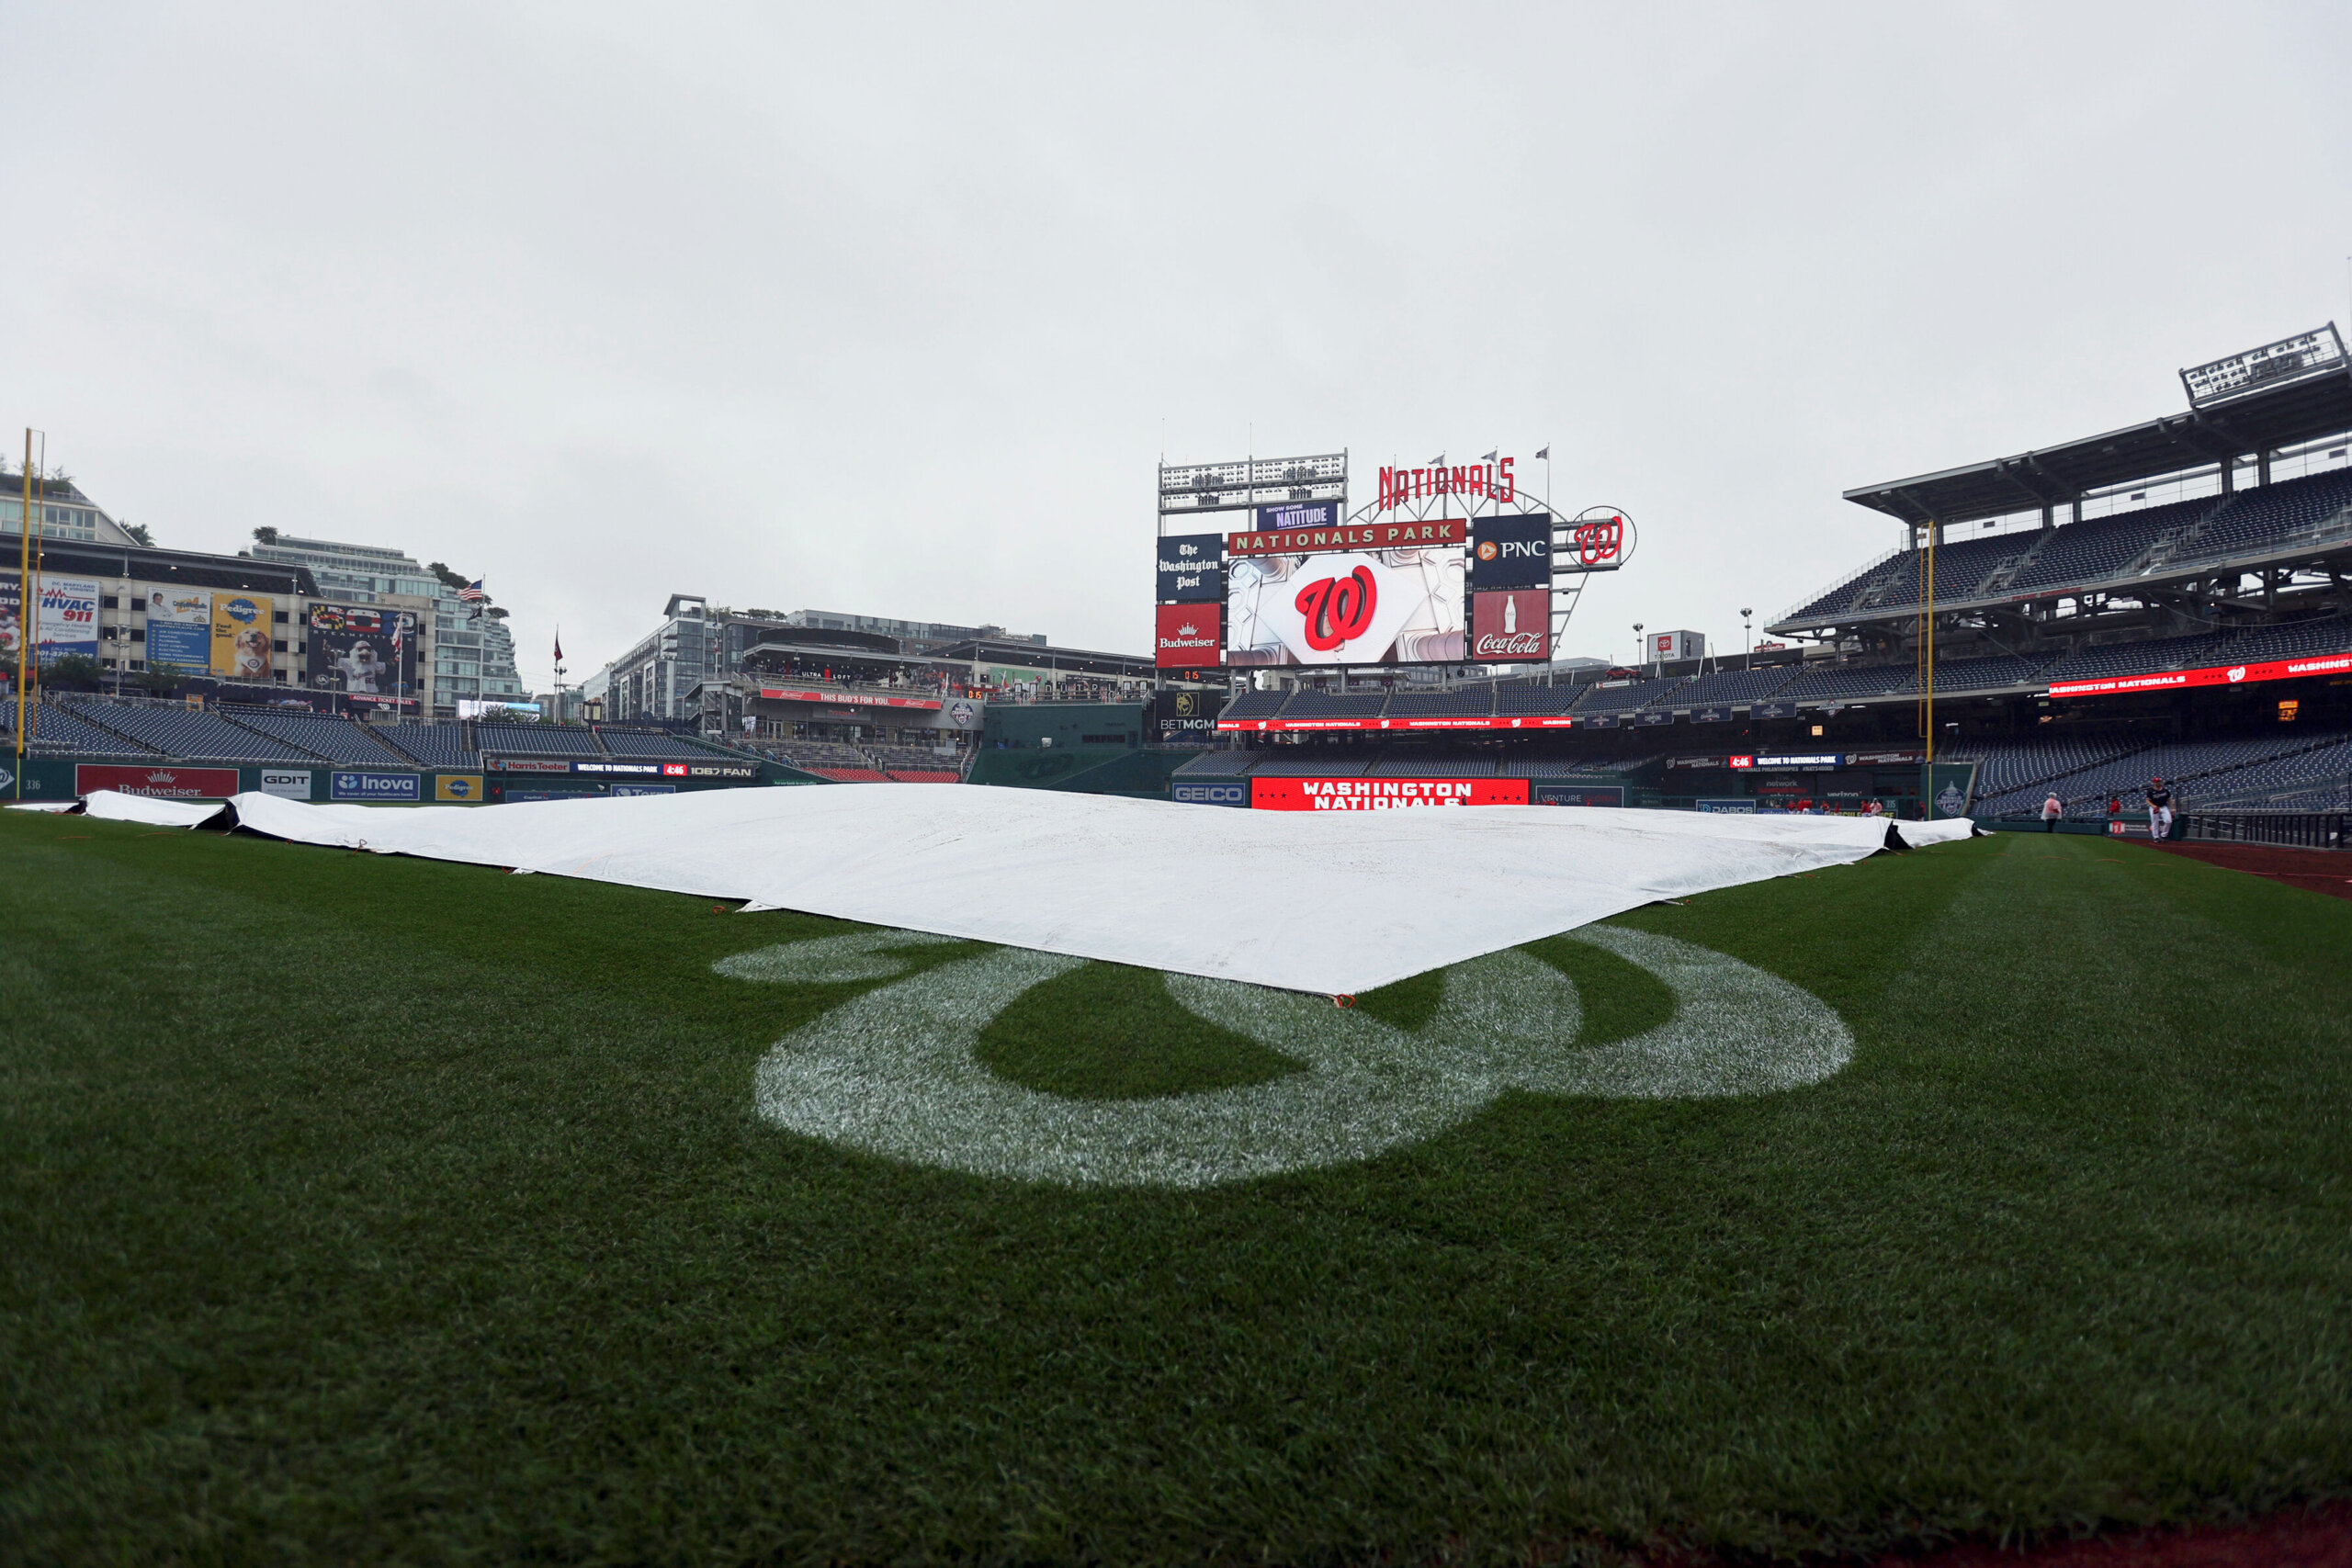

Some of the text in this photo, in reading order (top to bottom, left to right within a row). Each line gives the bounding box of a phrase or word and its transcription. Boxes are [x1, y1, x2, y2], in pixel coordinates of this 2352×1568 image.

[1379, 457, 1514, 512] NATIONALS
[1276, 507, 1328, 527] NATITUDE
[1236, 524, 1452, 549] NATIONALS PARK
[1179, 544, 1199, 557] The
[1499, 540, 1546, 558] PNC
[1159, 558, 1219, 574] Washington
[1176, 575, 1200, 591] Post
[41, 597, 96, 612] HVAC
[220, 603, 265, 615] Pedigree
[62, 610, 94, 623] 911
[1159, 637, 1216, 649] Budweiser
[1476, 632, 1544, 655] Coca-Cola
[2118, 675, 2186, 688] NATIONALS
[820, 694, 836, 702] THIS
[837, 694, 859, 703] BUD'S
[874, 697, 890, 705] YOU.
[1160, 719, 1216, 730] BETMGM
[1732, 757, 1749, 767] 4:46
[1757, 757, 1781, 765] WELCOME
[1790, 756, 1820, 764] NATIONALS
[1820, 755, 1837, 763] PARK
[1859, 752, 1900, 761] WASHINGTON
[1877, 755, 1913, 763] NATIONALS
[508, 761, 568, 771] Harris Teeter
[577, 763, 605, 772] WELCOME
[613, 764, 642, 773] NATIONALS
[643, 765, 658, 773] PARK
[666, 765, 684, 774] 4:46
[723, 768, 752, 776] FAN
[25, 779, 41, 790] 336
[264, 775, 310, 784] GDIT
[362, 775, 413, 790] Inova
[119, 784, 202, 797] Budweiser
[444, 784, 474, 792] Pedigree
[1175, 786, 1243, 802] GEICO
[1303, 782, 1472, 796] WASHINGTON
[1315, 795, 1461, 810] NATIONALS
[1541, 794, 1581, 802] VENTURE
[1885, 799, 1896, 809] 335
[1712, 807, 1753, 815] DABOS
